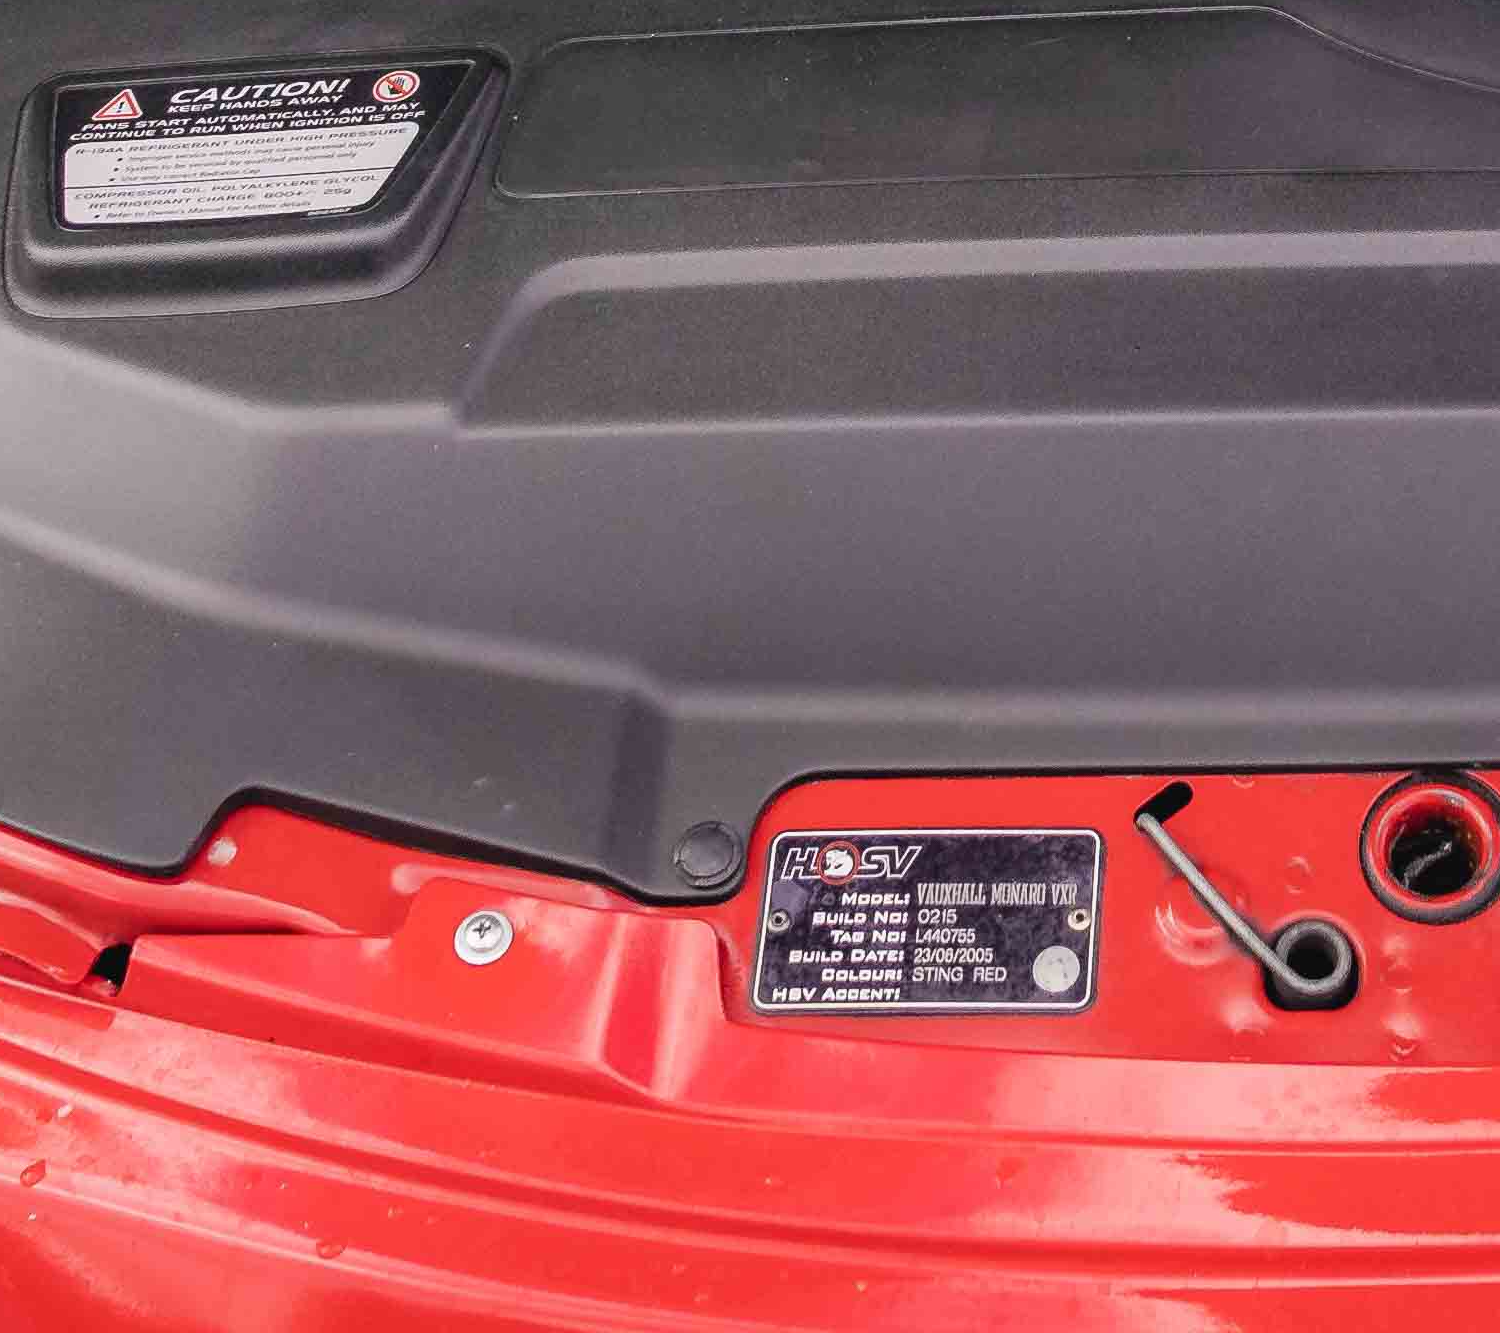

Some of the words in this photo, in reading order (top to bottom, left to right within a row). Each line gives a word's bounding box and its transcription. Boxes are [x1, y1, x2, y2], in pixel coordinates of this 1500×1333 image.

[170, 78, 351, 105] CAUTION!
[167, 103, 209, 114] KEEP
[220, 99, 279, 111] HANDS
[287, 95, 343, 107] AWAY
[69, 129, 157, 141] CONTINUE
[163, 127, 185, 136] TO
[190, 124, 229, 134] RUN
[233, 119, 287, 131] WHEN
[289, 115, 367, 128] IGNITION
[369, 113, 387, 122] IS
[389, 110, 426, 121] OFF
[81, 121, 131, 132] FANS
[134, 117, 189, 129] START
[341, 103, 387, 115] AND
[389, 101, 421, 112] MAY
[75, 146, 125, 155] R-134A
[128, 139, 230, 153] REFRIGERANT
[235, 136, 285, 145] UNDER
[290, 134, 325, 142] HIGH
[74, 187, 178, 200] COMPRESSOR
[323, 173, 382, 185] GLYCOL
[88, 196, 192, 210] REFRIGERANT
[780, 844, 923, 881] HSV
[841, 892, 911, 906] MODEL:
[916, 882, 987, 906] VAUXHALL
[990, 882, 1047, 906] MONARO
[1051, 883, 1078, 906] VXR
[812, 911, 868, 926] BUILD
[830, 929, 865, 944] TAG
[915, 927, 977, 945] L440755
[789, 949, 844, 964] BUILD
[850, 948, 904, 963] DATE:
[821, 968, 903, 982] COLOUR:
[911, 966, 965, 983] STING
[972, 966, 1009, 983] RED
[771, 987, 818, 1002] HSV
